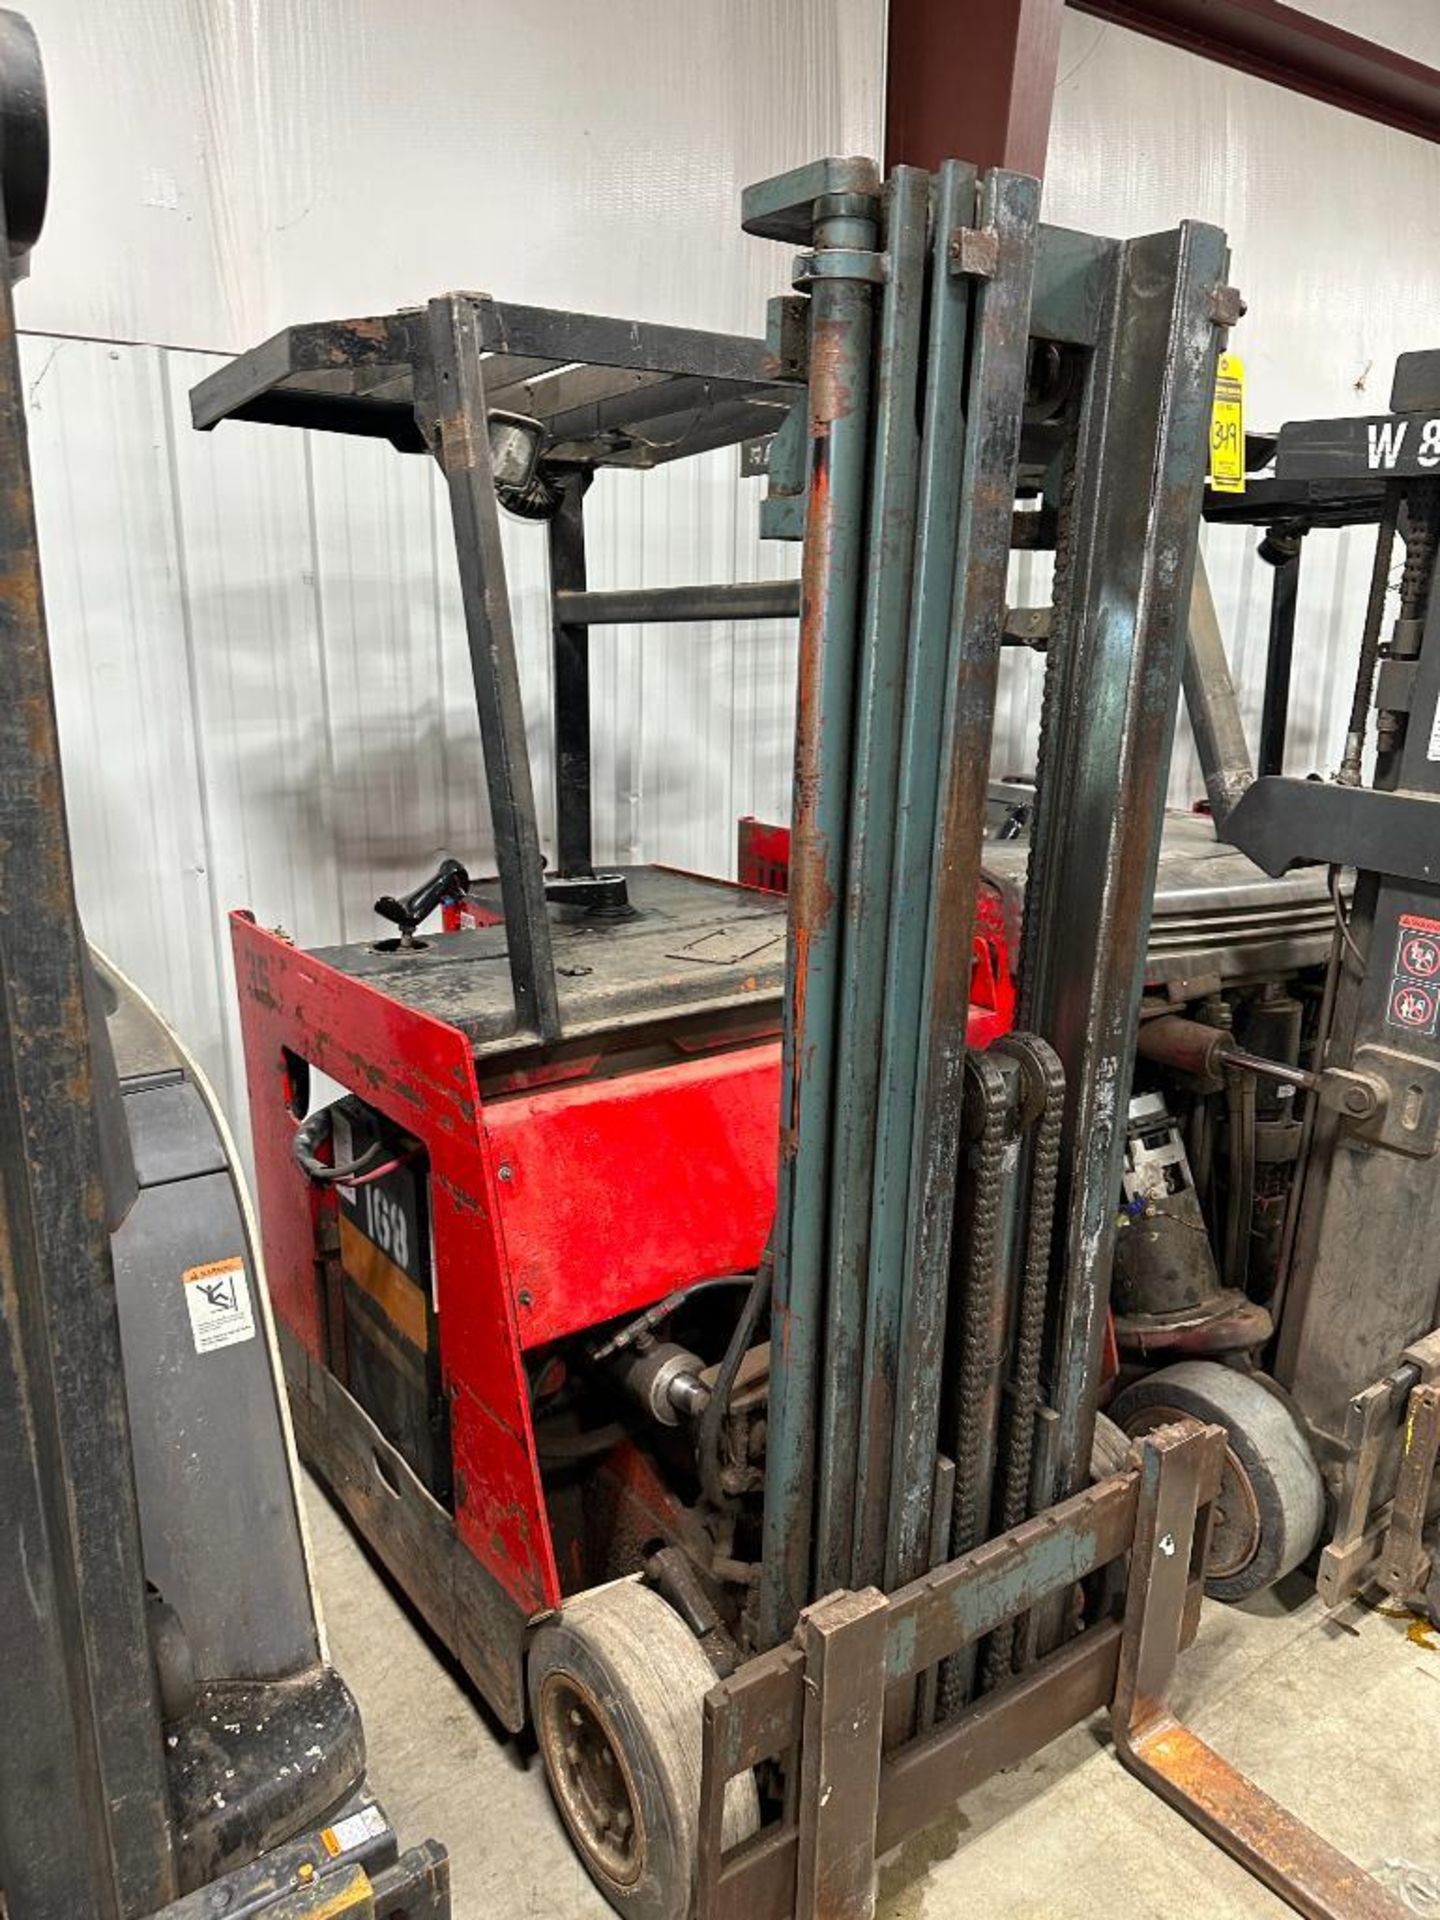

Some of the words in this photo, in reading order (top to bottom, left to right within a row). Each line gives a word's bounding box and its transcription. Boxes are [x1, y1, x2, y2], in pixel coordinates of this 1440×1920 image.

[1212, 421, 1237, 454] 349
[1367, 422, 1408, 469] W
[1417, 419, 1440, 467] 8
[366, 1184, 409, 1269] 168
